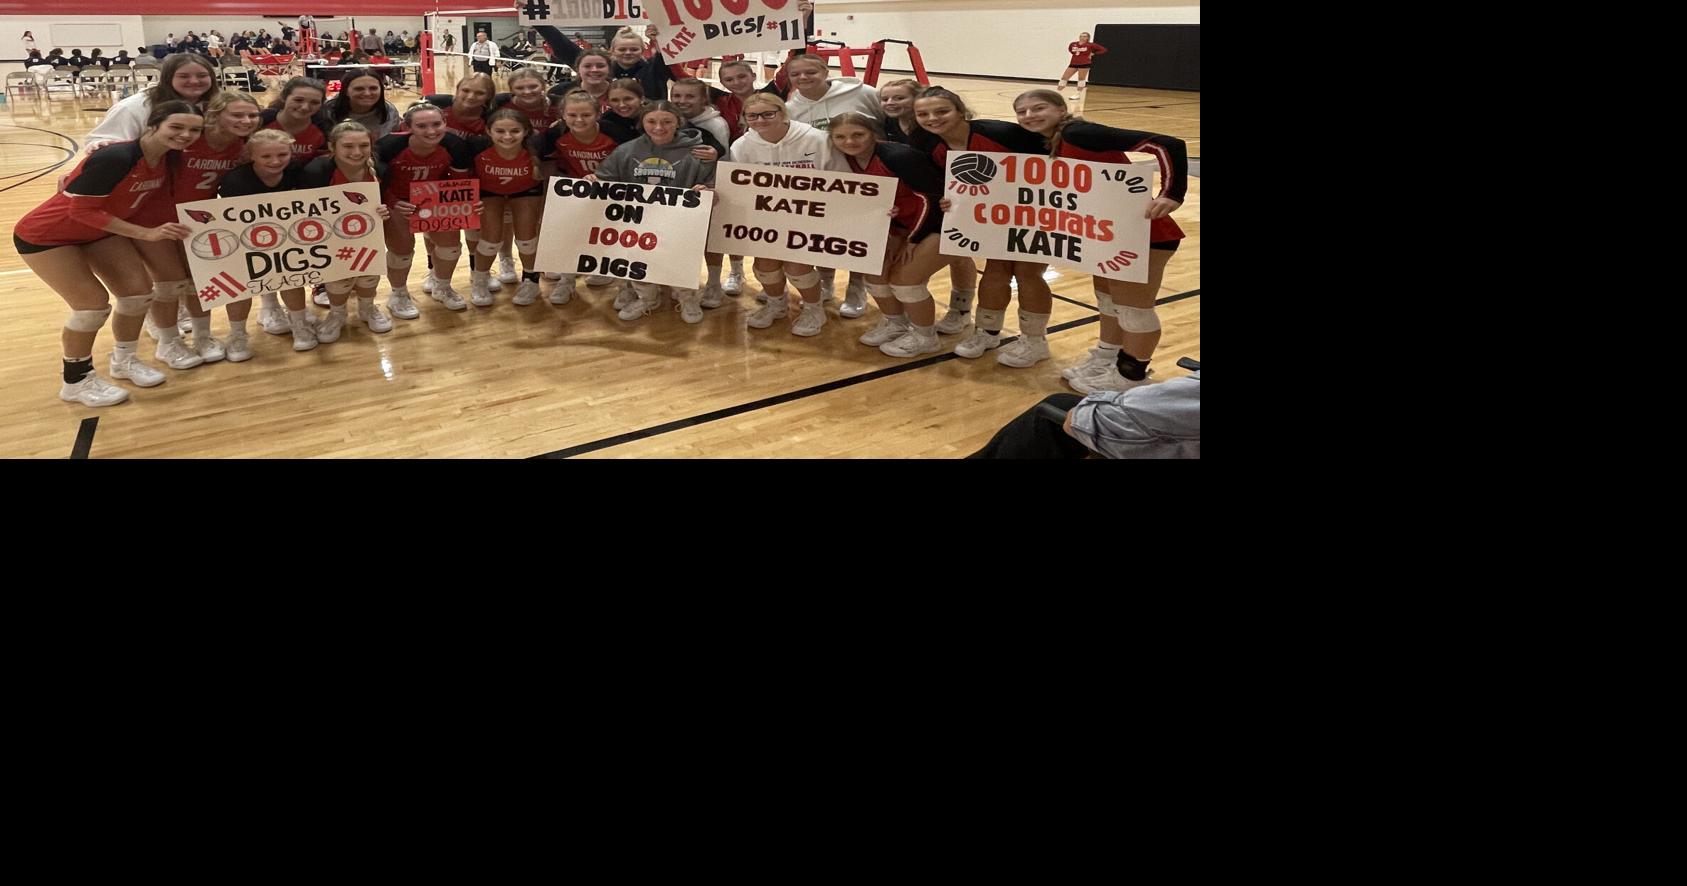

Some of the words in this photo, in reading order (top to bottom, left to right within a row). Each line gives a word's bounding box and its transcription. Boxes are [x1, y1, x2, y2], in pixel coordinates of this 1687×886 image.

[703, 15, 765, 40] DIGS!
[766, 19, 800, 41] #11
[662, 26, 696, 59] KATE
[195, 171, 218, 190] 2
[485, 164, 529, 177] CARDINALS
[730, 168, 880, 197] CONGRATS
[999, 155, 1093, 193] 1000
[1100, 169, 1148, 193] 1000
[439, 188, 475, 203] KATE
[554, 178, 701, 208] CONGRATS
[947, 180, 990, 196] 1000
[1018, 187, 1078, 211] DIGS
[223, 197, 341, 223] CONGRATS
[432, 203, 473, 218] 1000
[605, 203, 644, 224] ON
[755, 194, 826, 217] KATE
[973, 202, 1114, 242] congrats
[208, 214, 368, 257] 1000
[588, 226, 658, 251] 1000
[722, 223, 779, 243] 1000
[786, 230, 868, 257] DIGS
[943, 227, 980, 252] 1000
[1006, 228, 1082, 262] KATE
[245, 245, 332, 280] DIGS
[335, 246, 378, 272] #11
[577, 254, 648, 280] DIGS
[1097, 250, 1138, 274] 1000
[200, 271, 247, 302] #11
[246, 271, 324, 295] KATE
